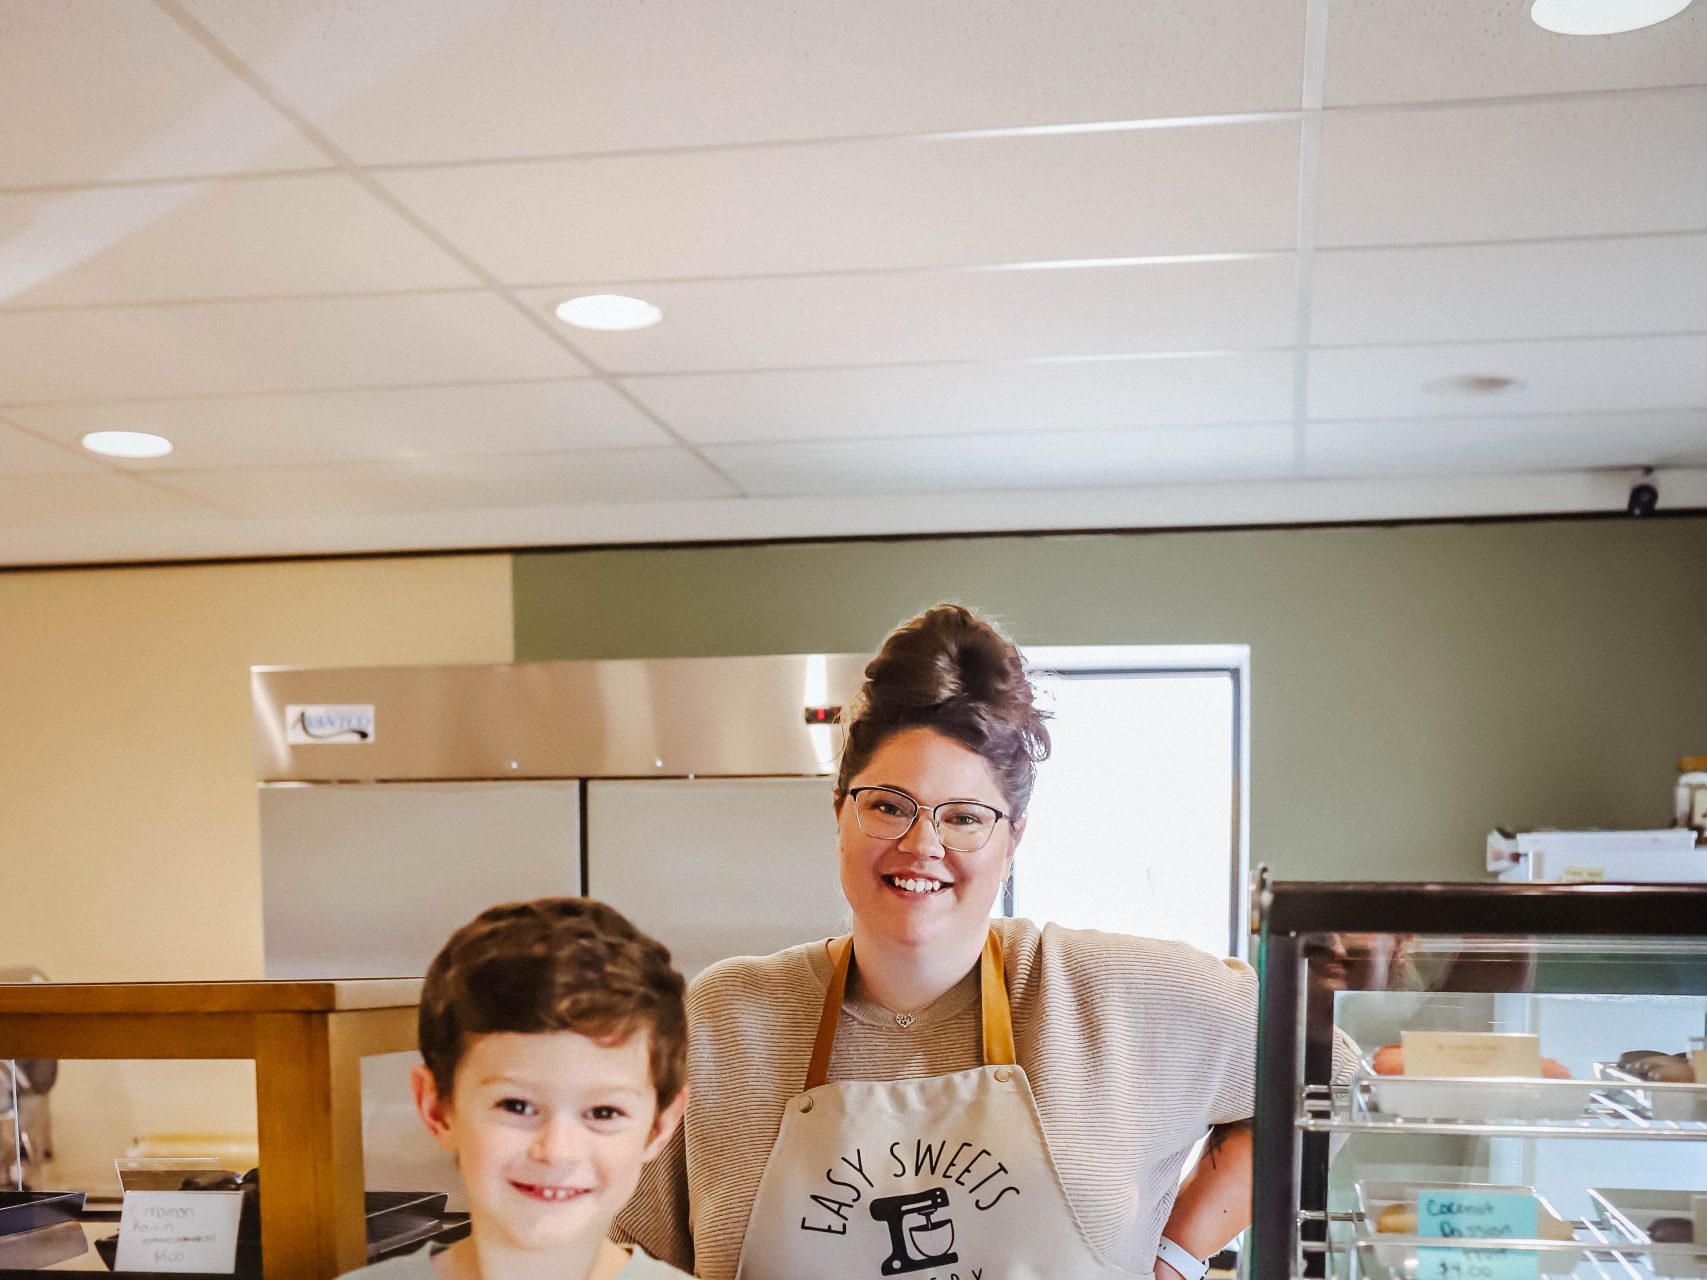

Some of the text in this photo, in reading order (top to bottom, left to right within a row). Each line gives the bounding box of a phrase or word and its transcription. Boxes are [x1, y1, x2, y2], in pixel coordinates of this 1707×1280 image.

[130, 1204, 196, 1218] Cnnamon
[801, 1139, 1020, 1235] EASY SWEETS
